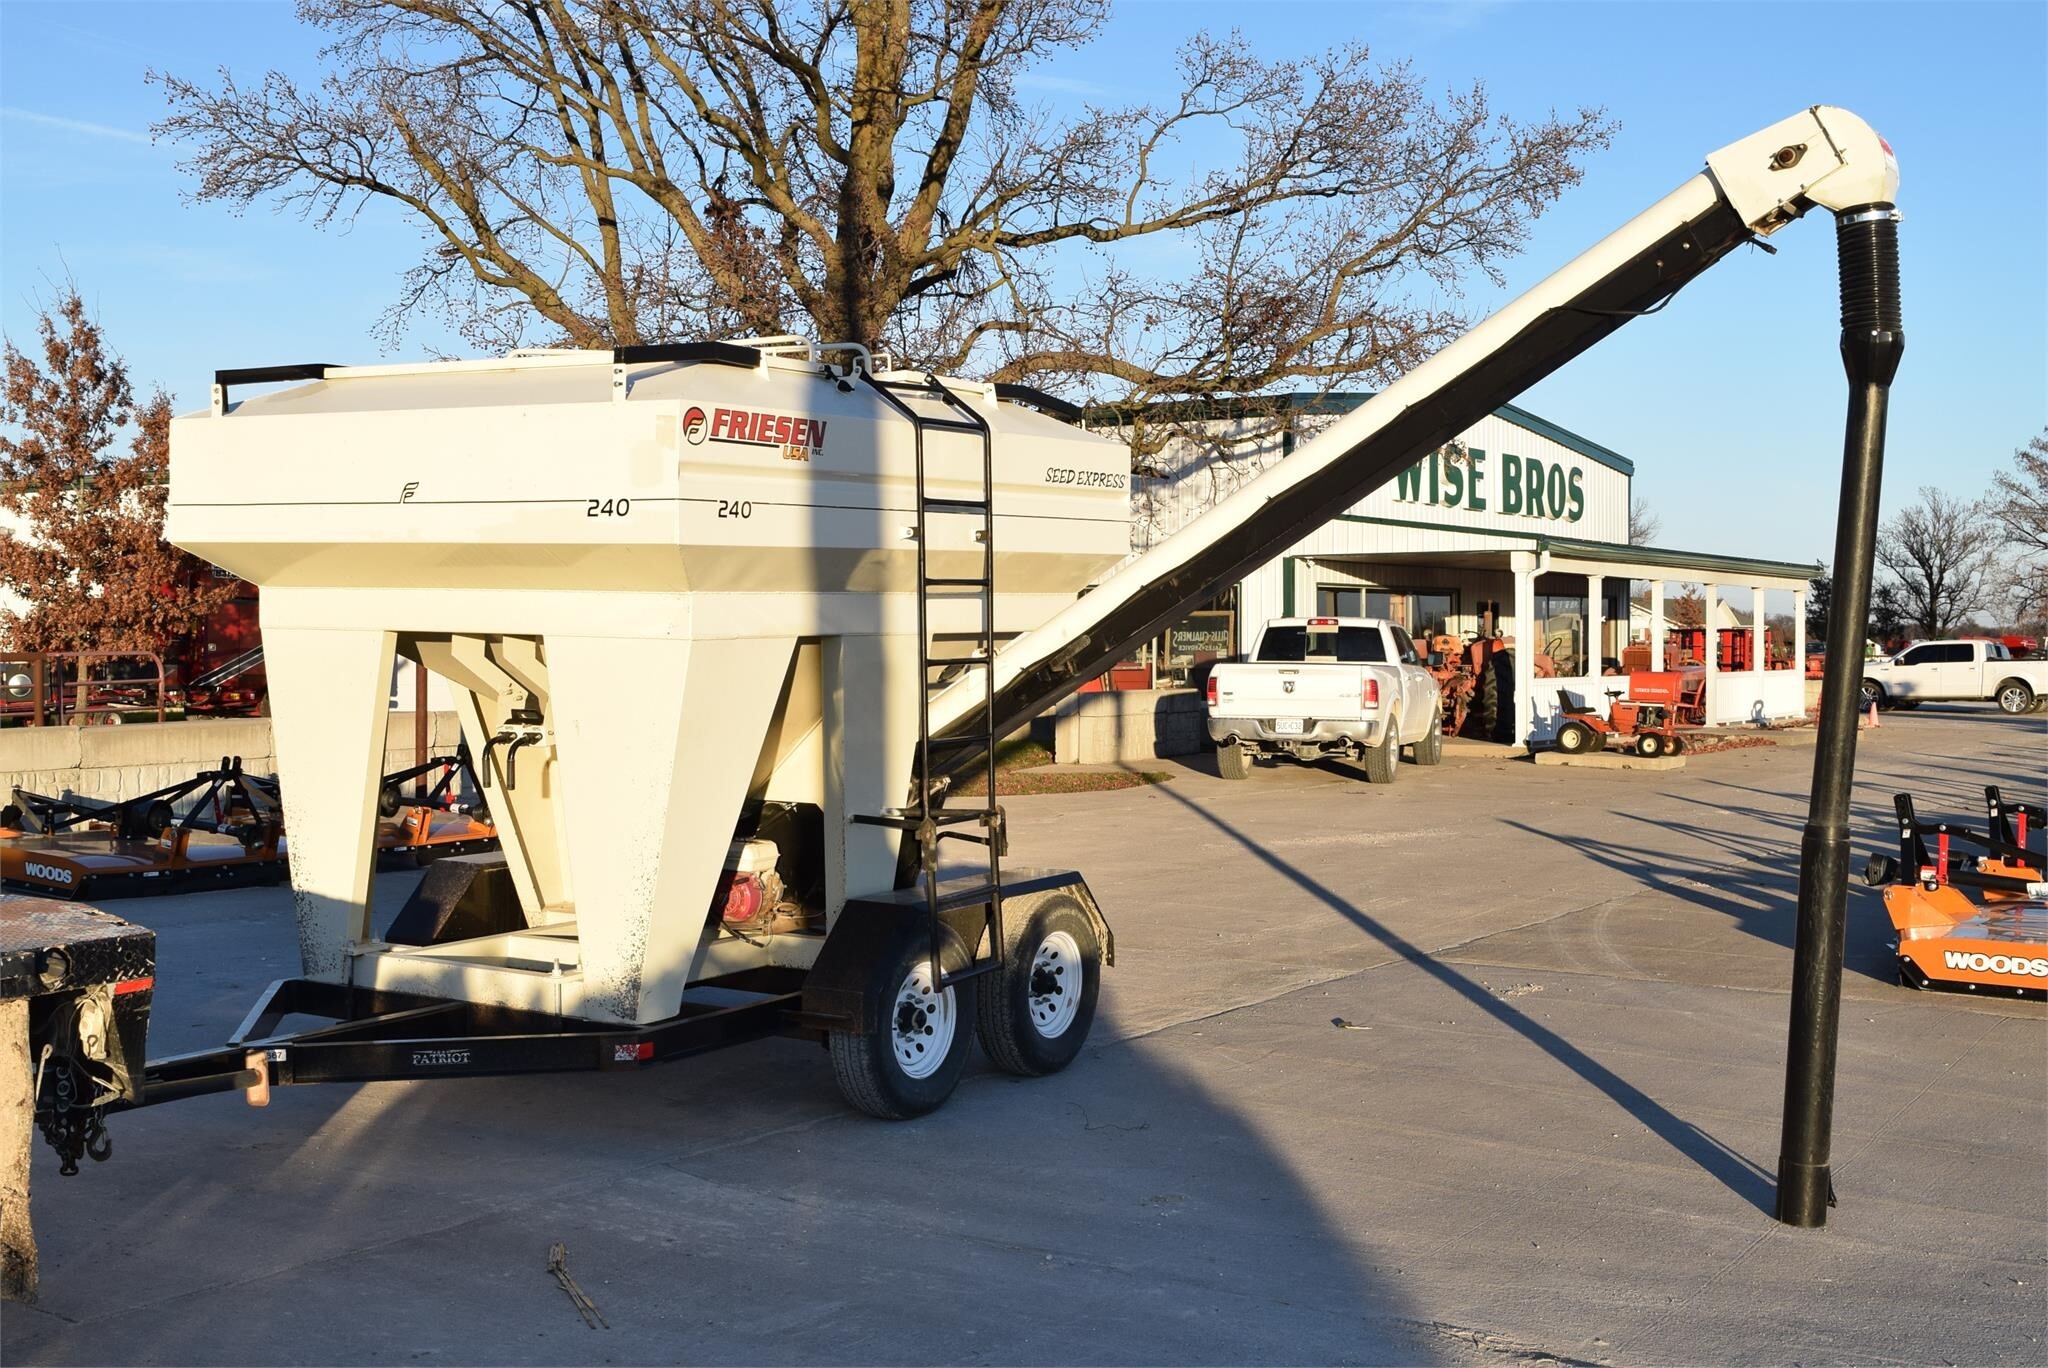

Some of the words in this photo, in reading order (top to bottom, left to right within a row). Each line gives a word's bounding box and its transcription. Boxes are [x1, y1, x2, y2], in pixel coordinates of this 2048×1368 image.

[711, 408, 827, 448] FRIESEN
[783, 445, 808, 461] USA
[1045, 467, 1075, 484] SEED
[1077, 470, 1126, 488] EXPRESS
[1397, 447, 1486, 511] WISE
[1502, 453, 1584, 522] BROS
[587, 499, 630, 517] 240
[718, 500, 751, 518] 240
[25, 862, 72, 884] WOODS
[1944, 950, 2048, 976] WOODS
[412, 1052, 470, 1065] PATRIOT
